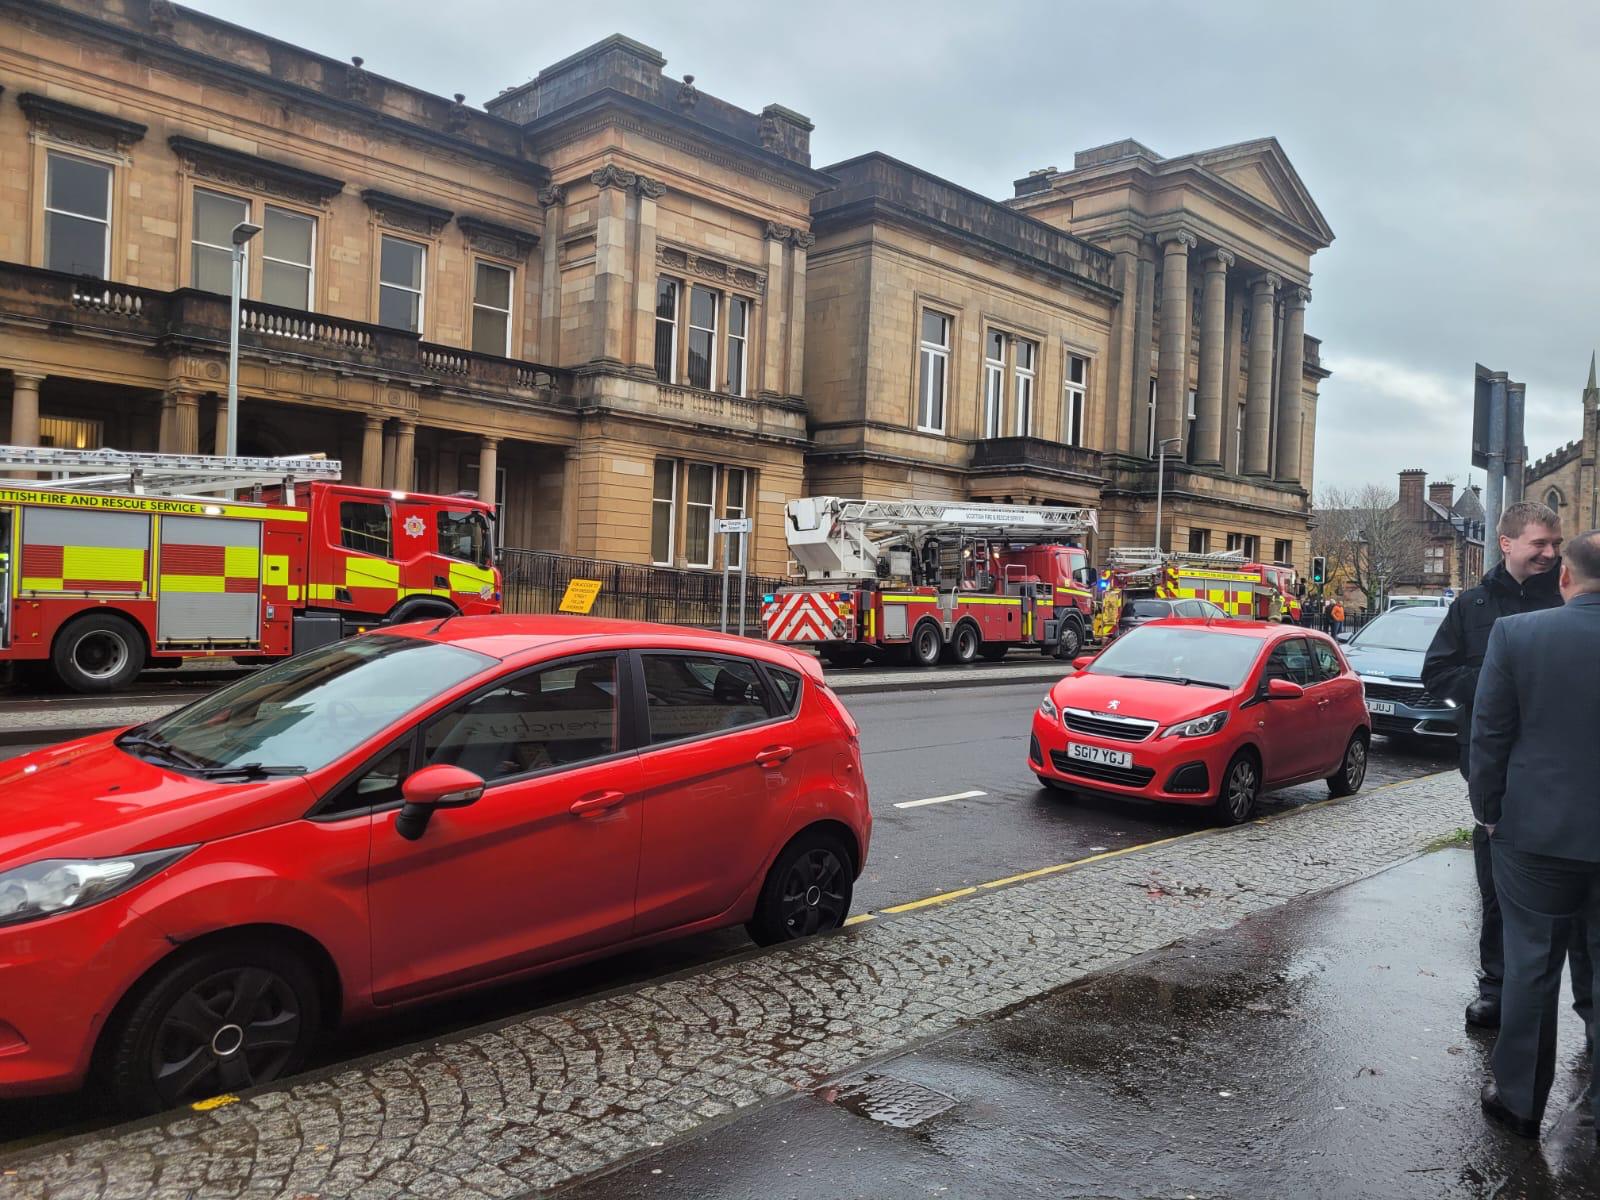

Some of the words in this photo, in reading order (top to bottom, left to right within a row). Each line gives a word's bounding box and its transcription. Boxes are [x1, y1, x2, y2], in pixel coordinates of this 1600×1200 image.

[40, 494, 67, 504] FIRE
[71, 496, 98, 506] AND
[102, 498, 146, 509] RESCUE
[151, 501, 196, 513] SERVICE
[1373, 703, 1391, 712] JUJ
[1074, 745, 1098, 760] SG17
[1102, 750, 1125, 765] YGJ
